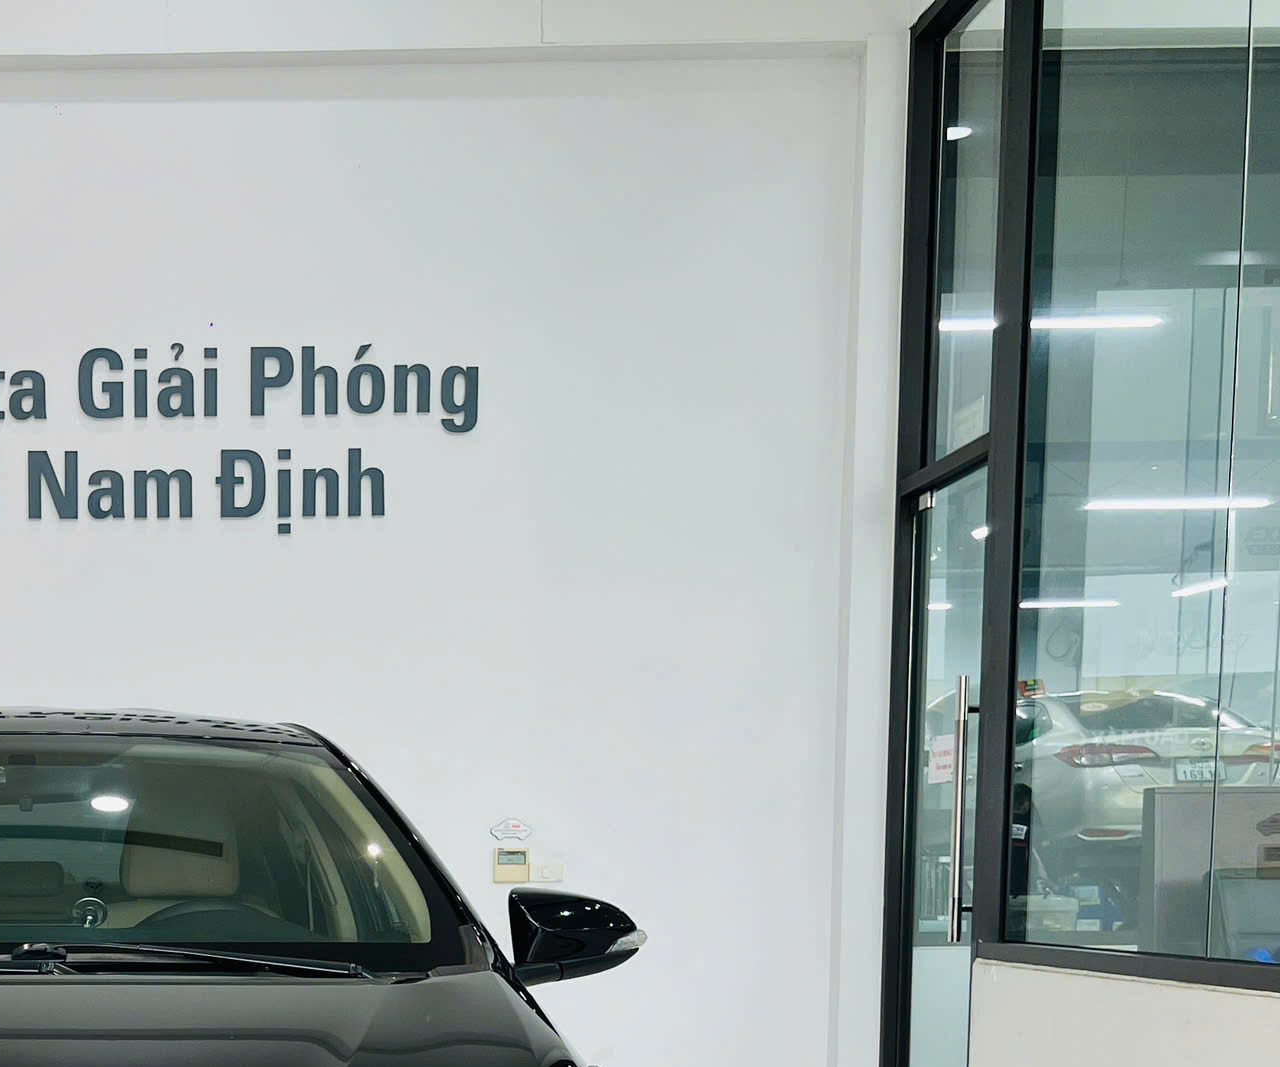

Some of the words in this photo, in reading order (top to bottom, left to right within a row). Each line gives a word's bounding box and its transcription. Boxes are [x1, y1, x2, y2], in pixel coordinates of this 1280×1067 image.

[77, 342, 218, 420] Giải
[249, 343, 480, 434] Phóng
[27, 449, 193, 521] Nam
[214, 447, 386, 535] Định
